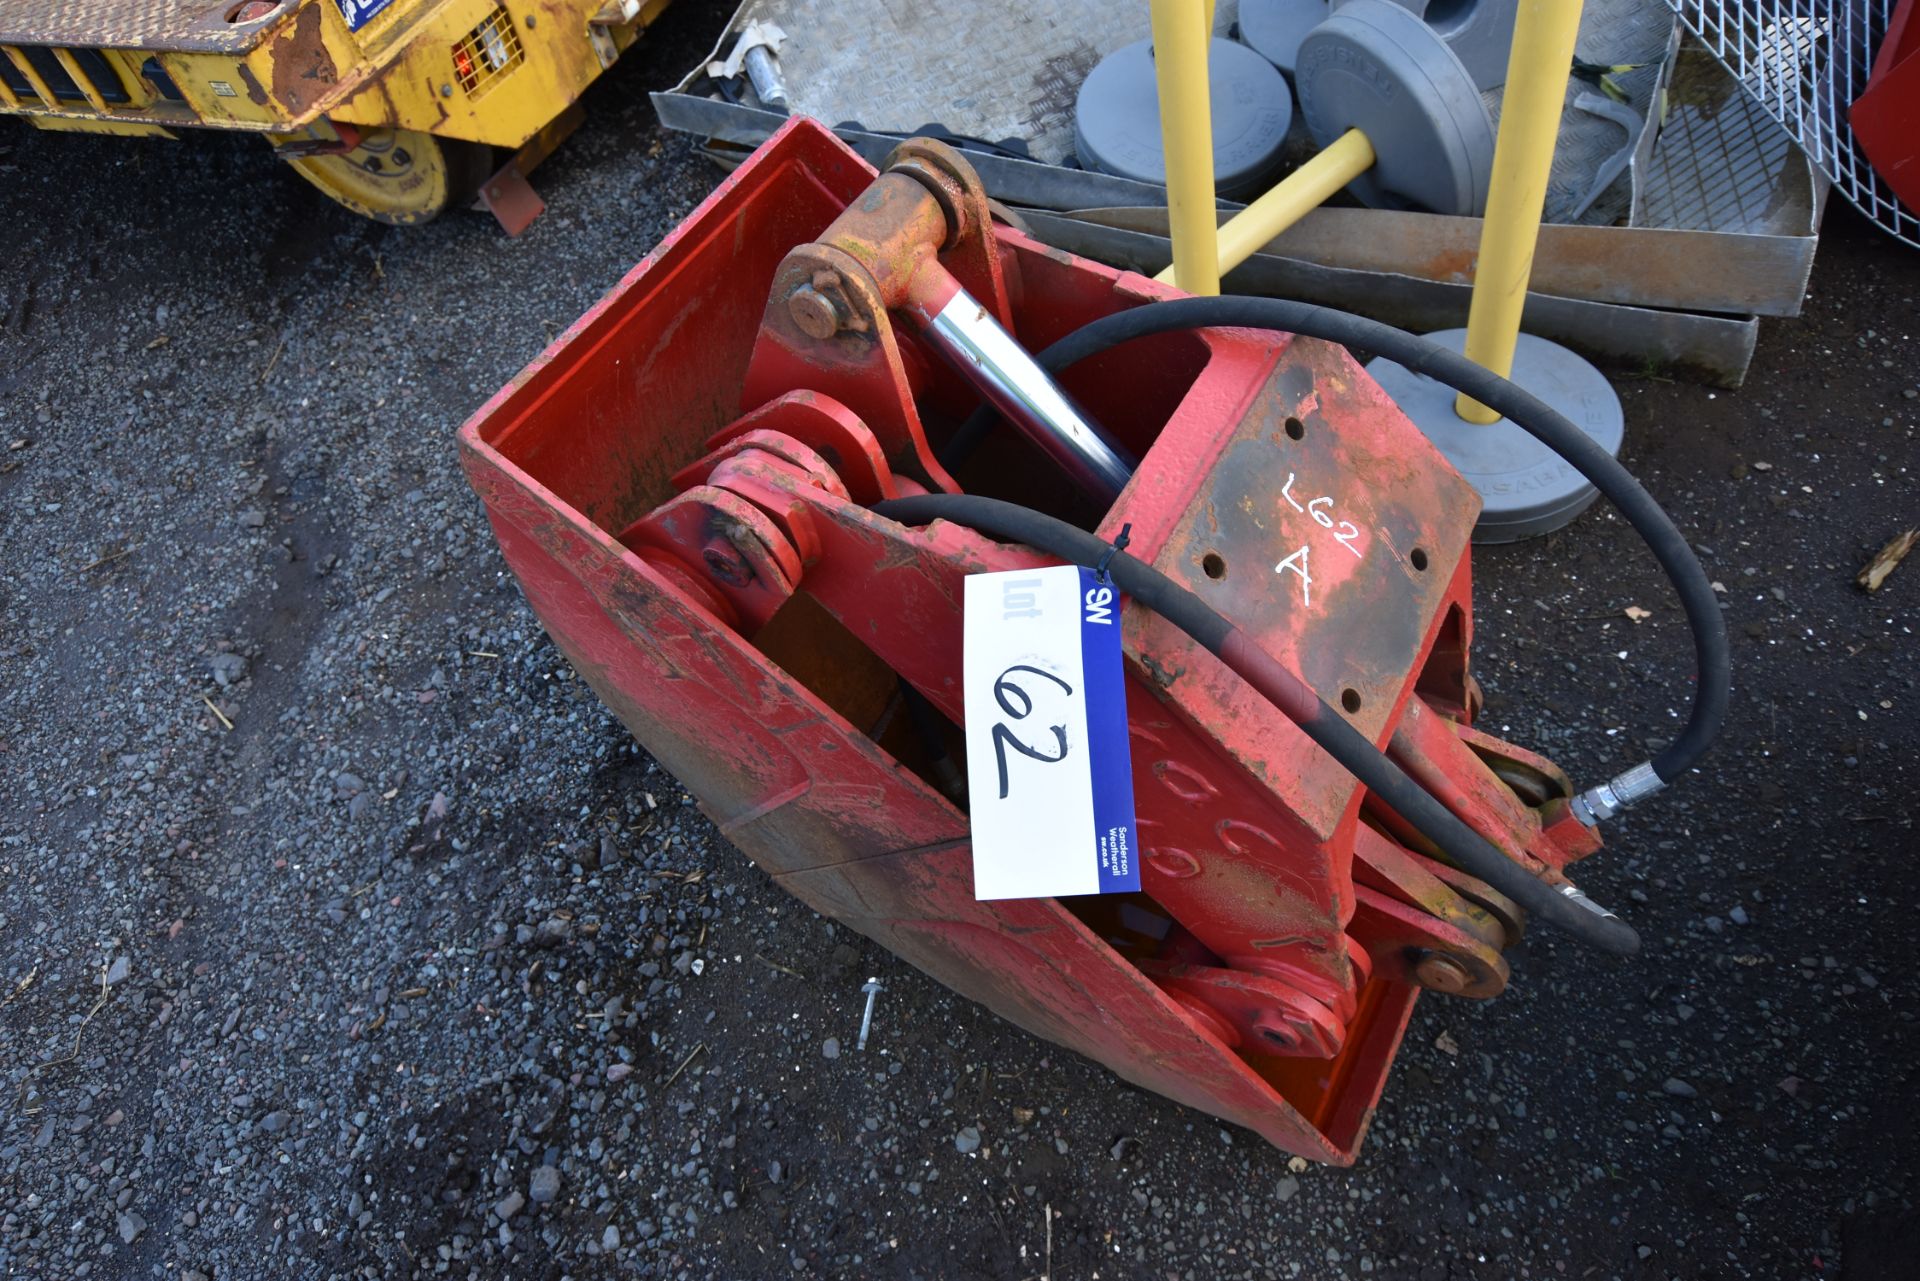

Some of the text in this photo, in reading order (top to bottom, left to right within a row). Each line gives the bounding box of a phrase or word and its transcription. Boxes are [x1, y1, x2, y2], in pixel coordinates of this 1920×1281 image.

[1282, 472, 1362, 558] L62
[1002, 578, 1043, 621] Lot
[1275, 545, 1312, 607] A
[1086, 588, 1112, 625] SW
[992, 664, 1073, 799] 62
[1100, 836, 1109, 868] sw.co.uk
[1108, 827, 1121, 877] Weatherall
[1118, 826, 1129, 876] Sanderson
